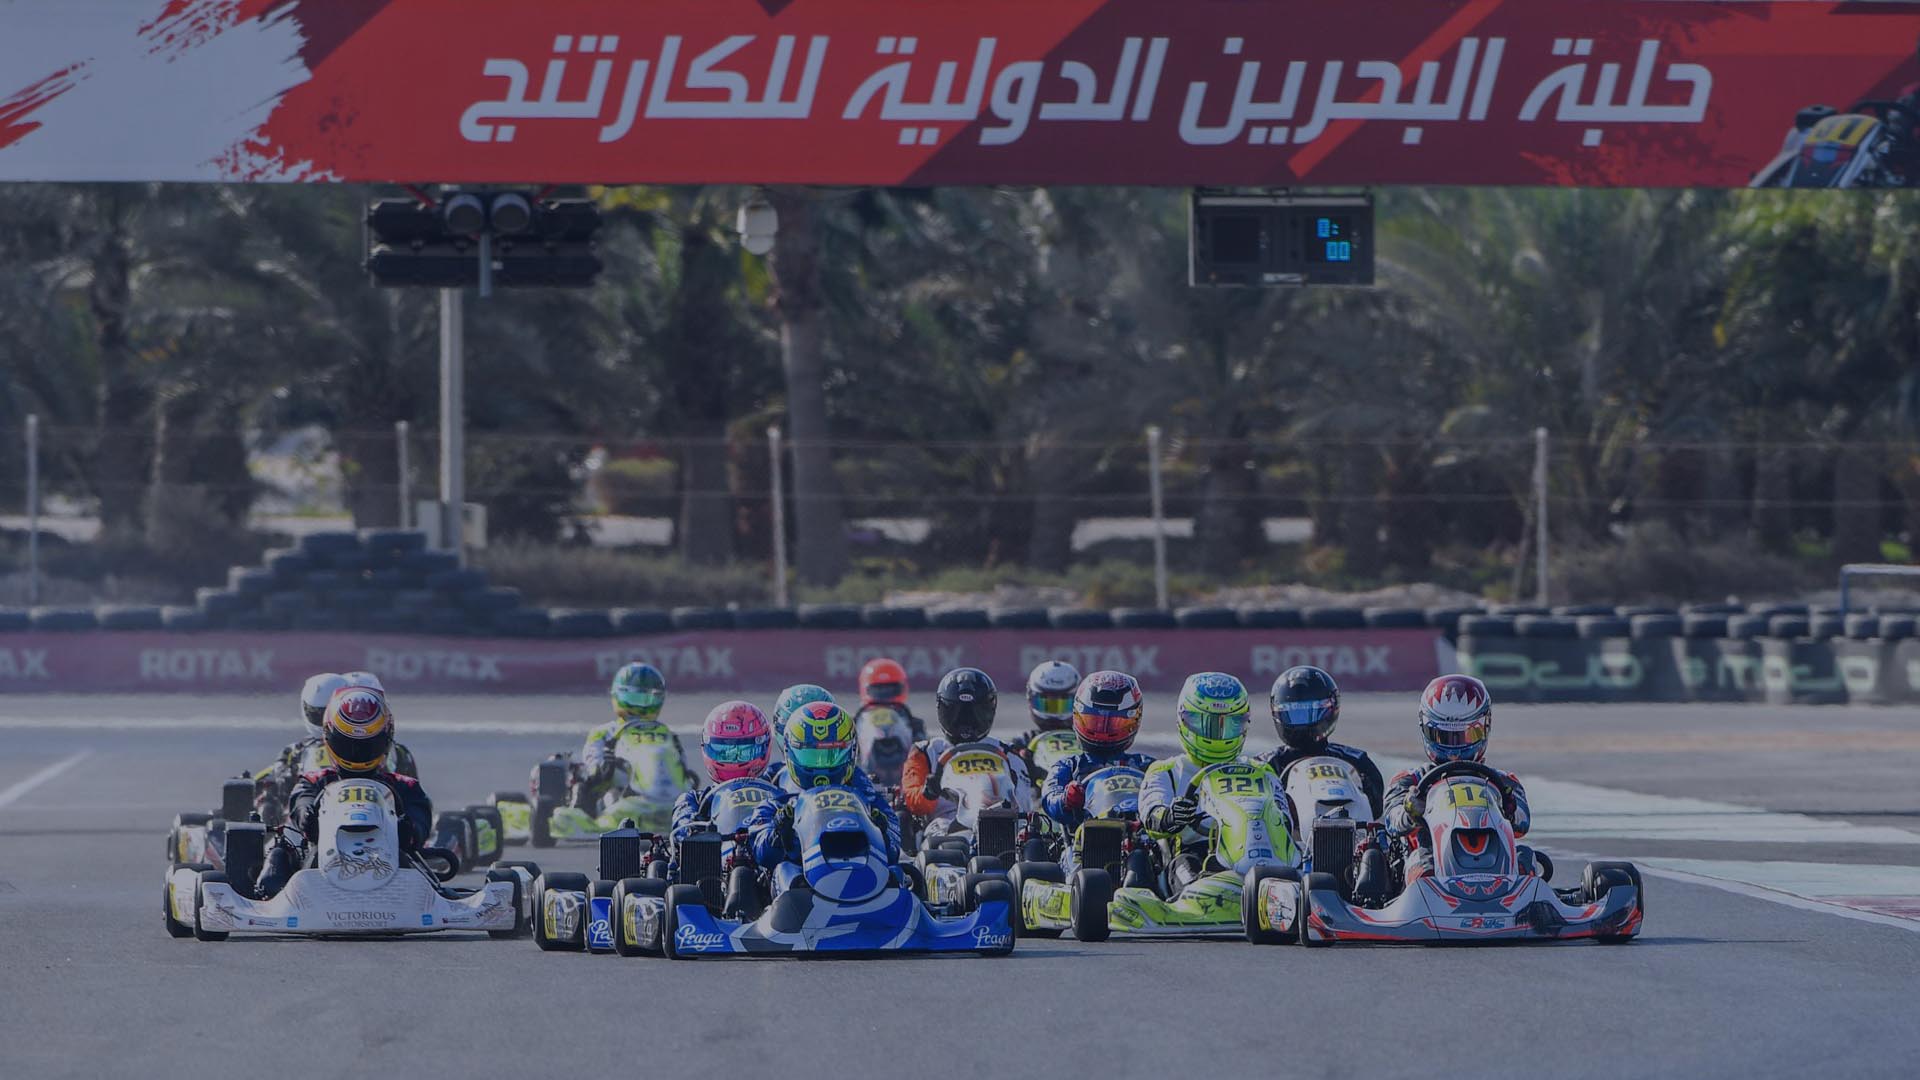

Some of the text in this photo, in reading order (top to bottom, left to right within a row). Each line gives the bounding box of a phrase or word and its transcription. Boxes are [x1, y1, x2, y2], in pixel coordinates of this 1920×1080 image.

[459, 35, 1713, 146] حلبة البحرين الدولية للكارتنج
[139, 648, 277, 679] ROTAX
[367, 649, 502, 680] ROTAX
[1252, 646, 1390, 675] ROTAX
[338, 787, 378, 803] 318
[1217, 777, 1265, 794] 321
[326, 911, 397, 921] VICTORIOUS
[676, 924, 724, 951] Praga
